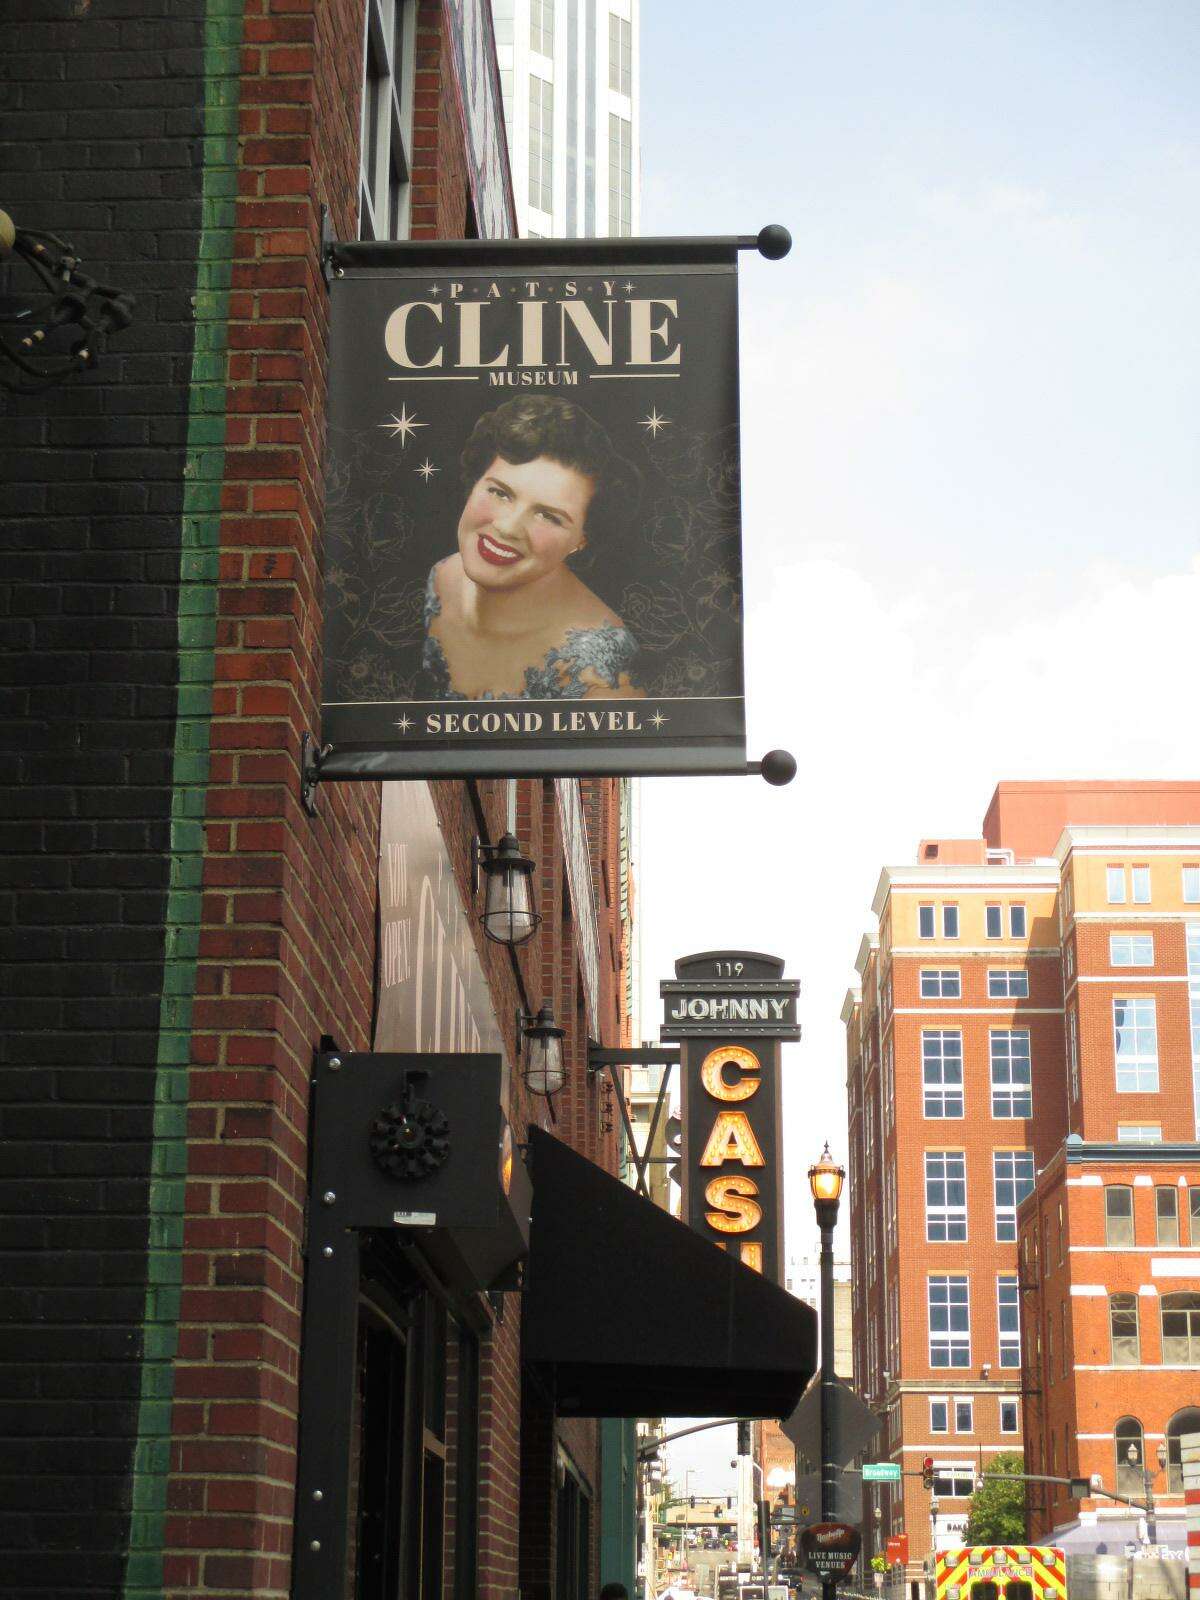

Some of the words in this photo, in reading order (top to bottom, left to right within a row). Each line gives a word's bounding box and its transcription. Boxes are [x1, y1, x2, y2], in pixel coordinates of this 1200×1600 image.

[384, 299, 681, 369] CLINE
[489, 371, 578, 386] MUSEUM
[426, 713, 543, 734] SECOND
[552, 711, 642, 732] LEVEL
[715, 962, 744, 977] 119
[671, 998, 790, 1020] JOHNNY
[700, 1045, 766, 1274] CAS
[808, 1552, 826, 1560] LIVE
[828, 1552, 852, 1560] MUSIC
